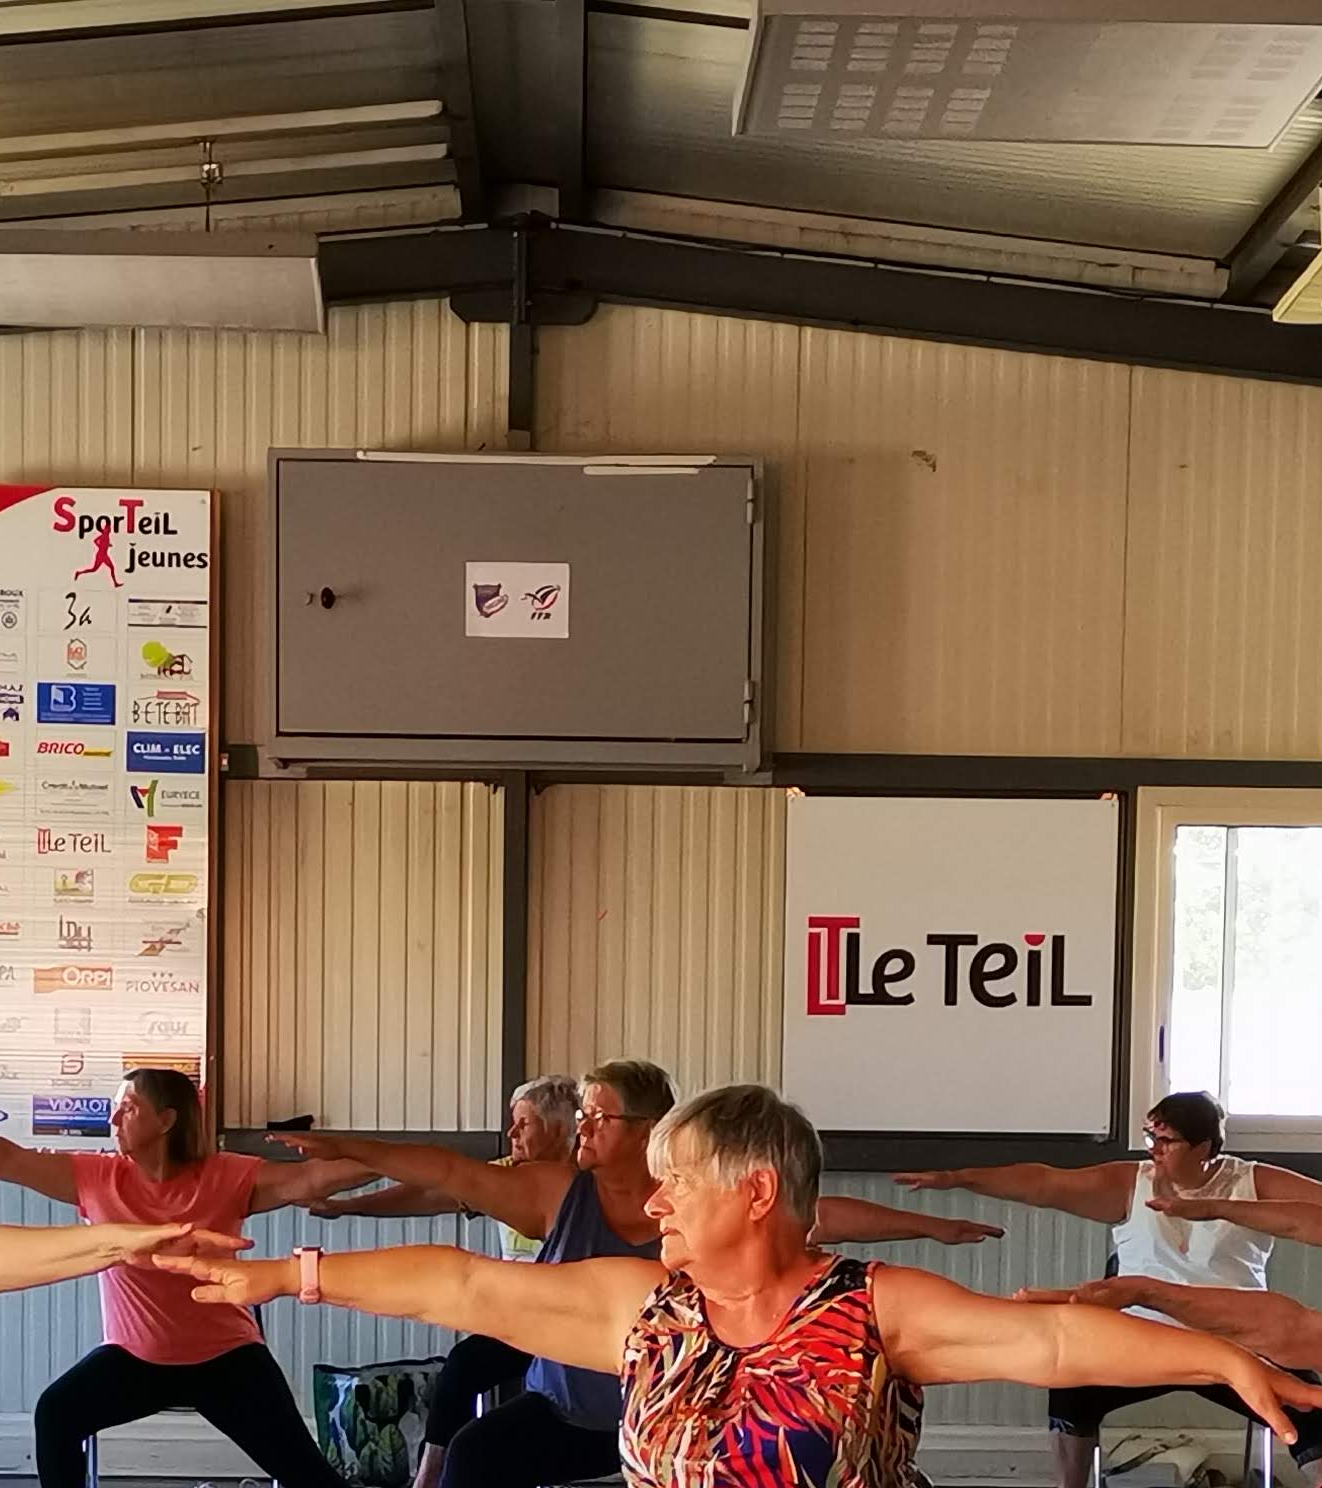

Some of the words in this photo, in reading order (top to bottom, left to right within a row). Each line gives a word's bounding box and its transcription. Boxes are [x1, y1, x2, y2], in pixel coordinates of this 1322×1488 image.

[124, 543, 209, 574] jeunes
[37, 742, 84, 755] BRICO
[173, 744, 201, 755] ELEC
